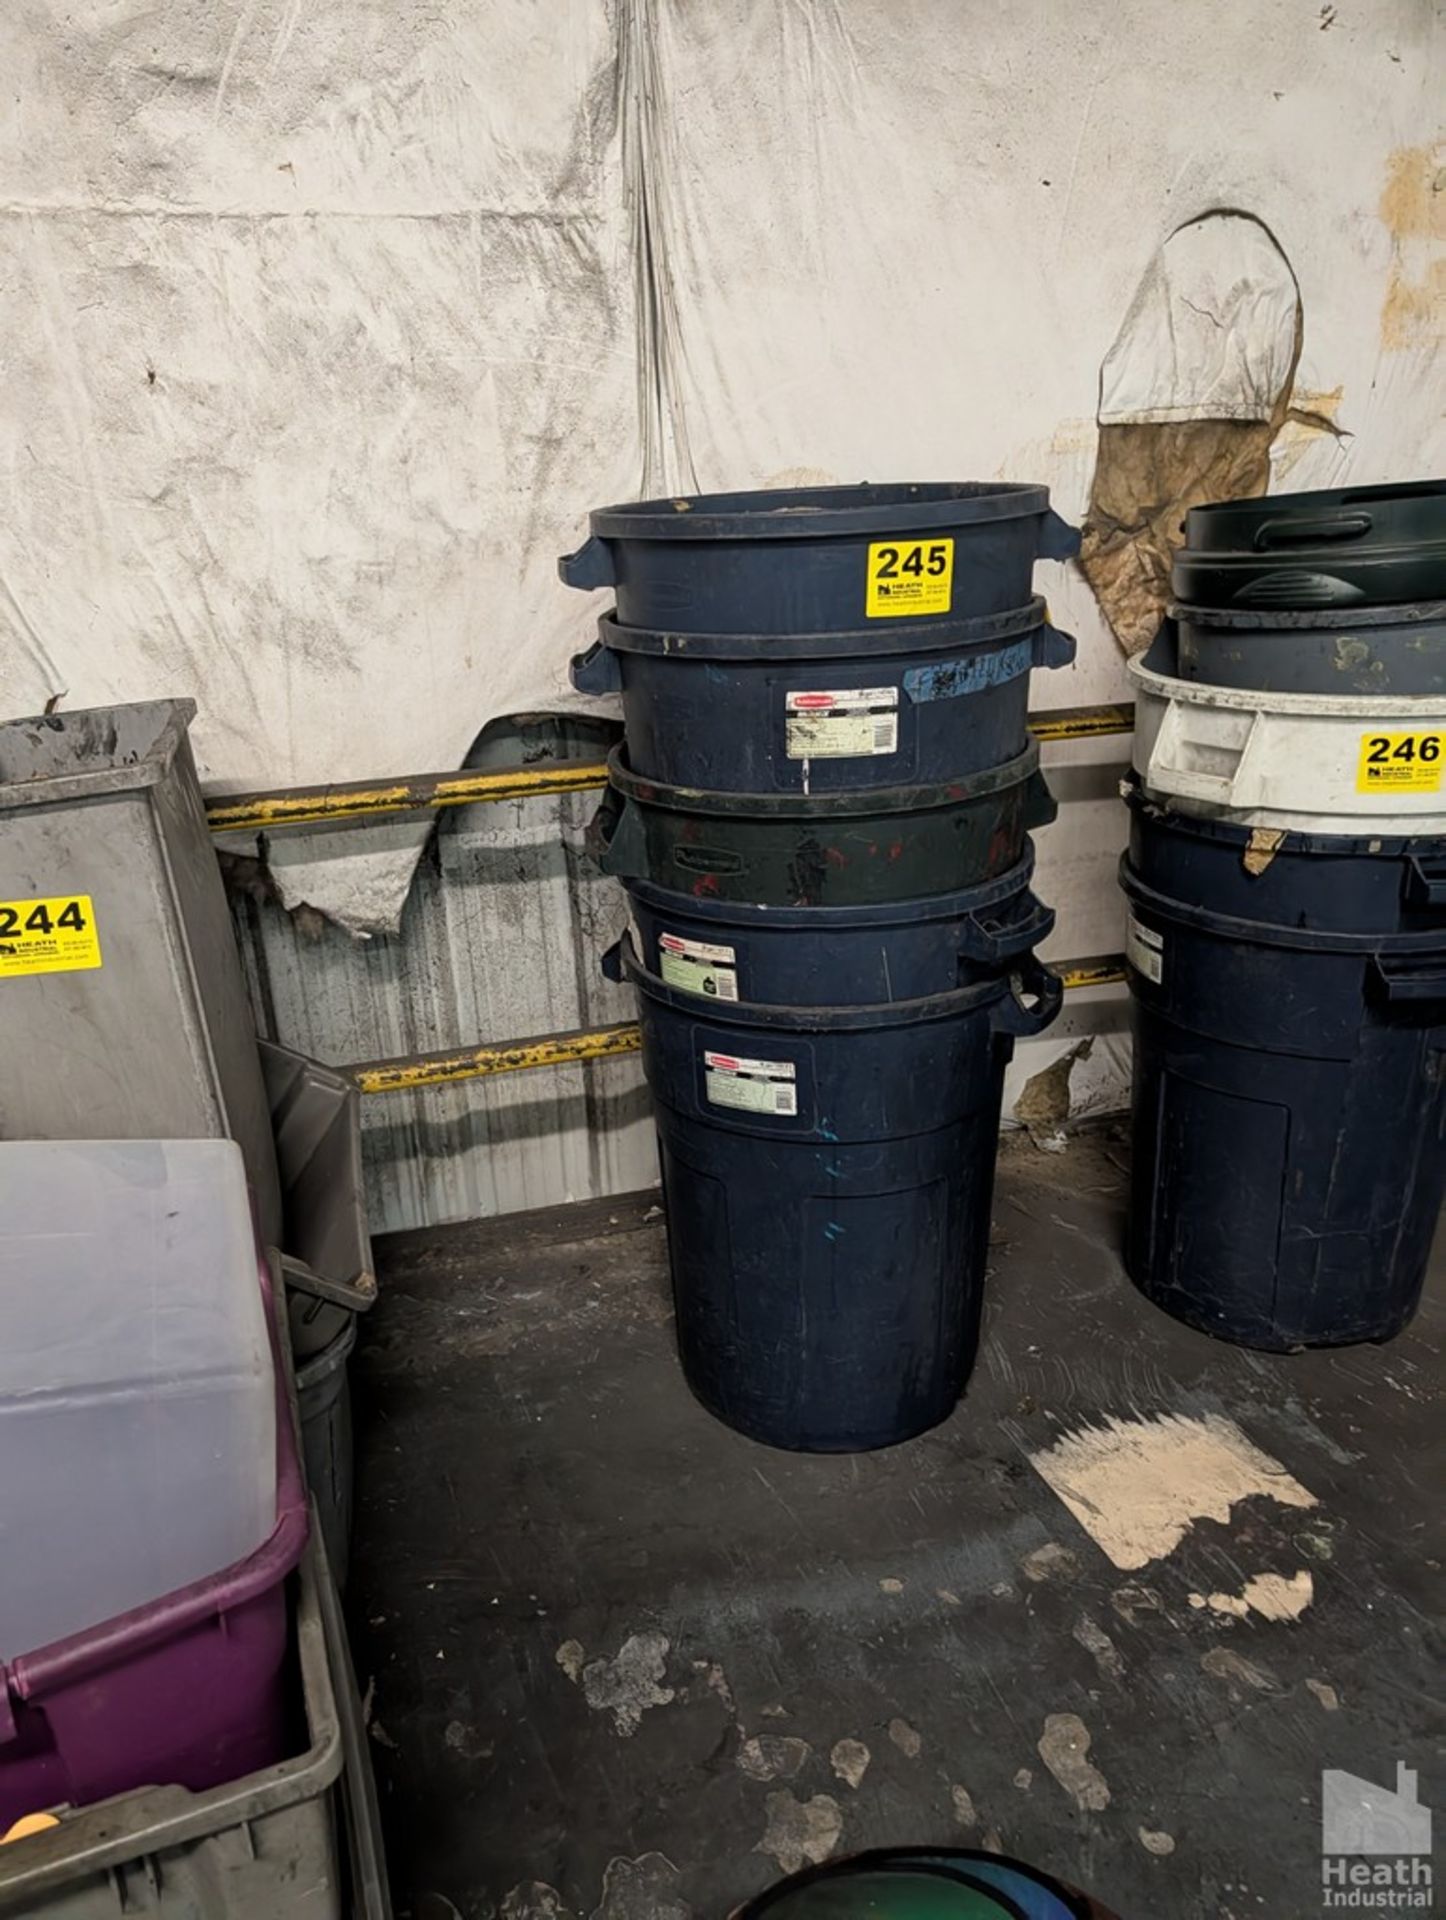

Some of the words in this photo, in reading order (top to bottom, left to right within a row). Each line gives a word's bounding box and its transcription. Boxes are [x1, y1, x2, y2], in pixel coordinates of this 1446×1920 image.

[876, 546, 946, 579] 245
[1367, 736, 1440, 762] 246
[0, 902, 86, 937] 244
[17, 939, 57, 948] HEATH
